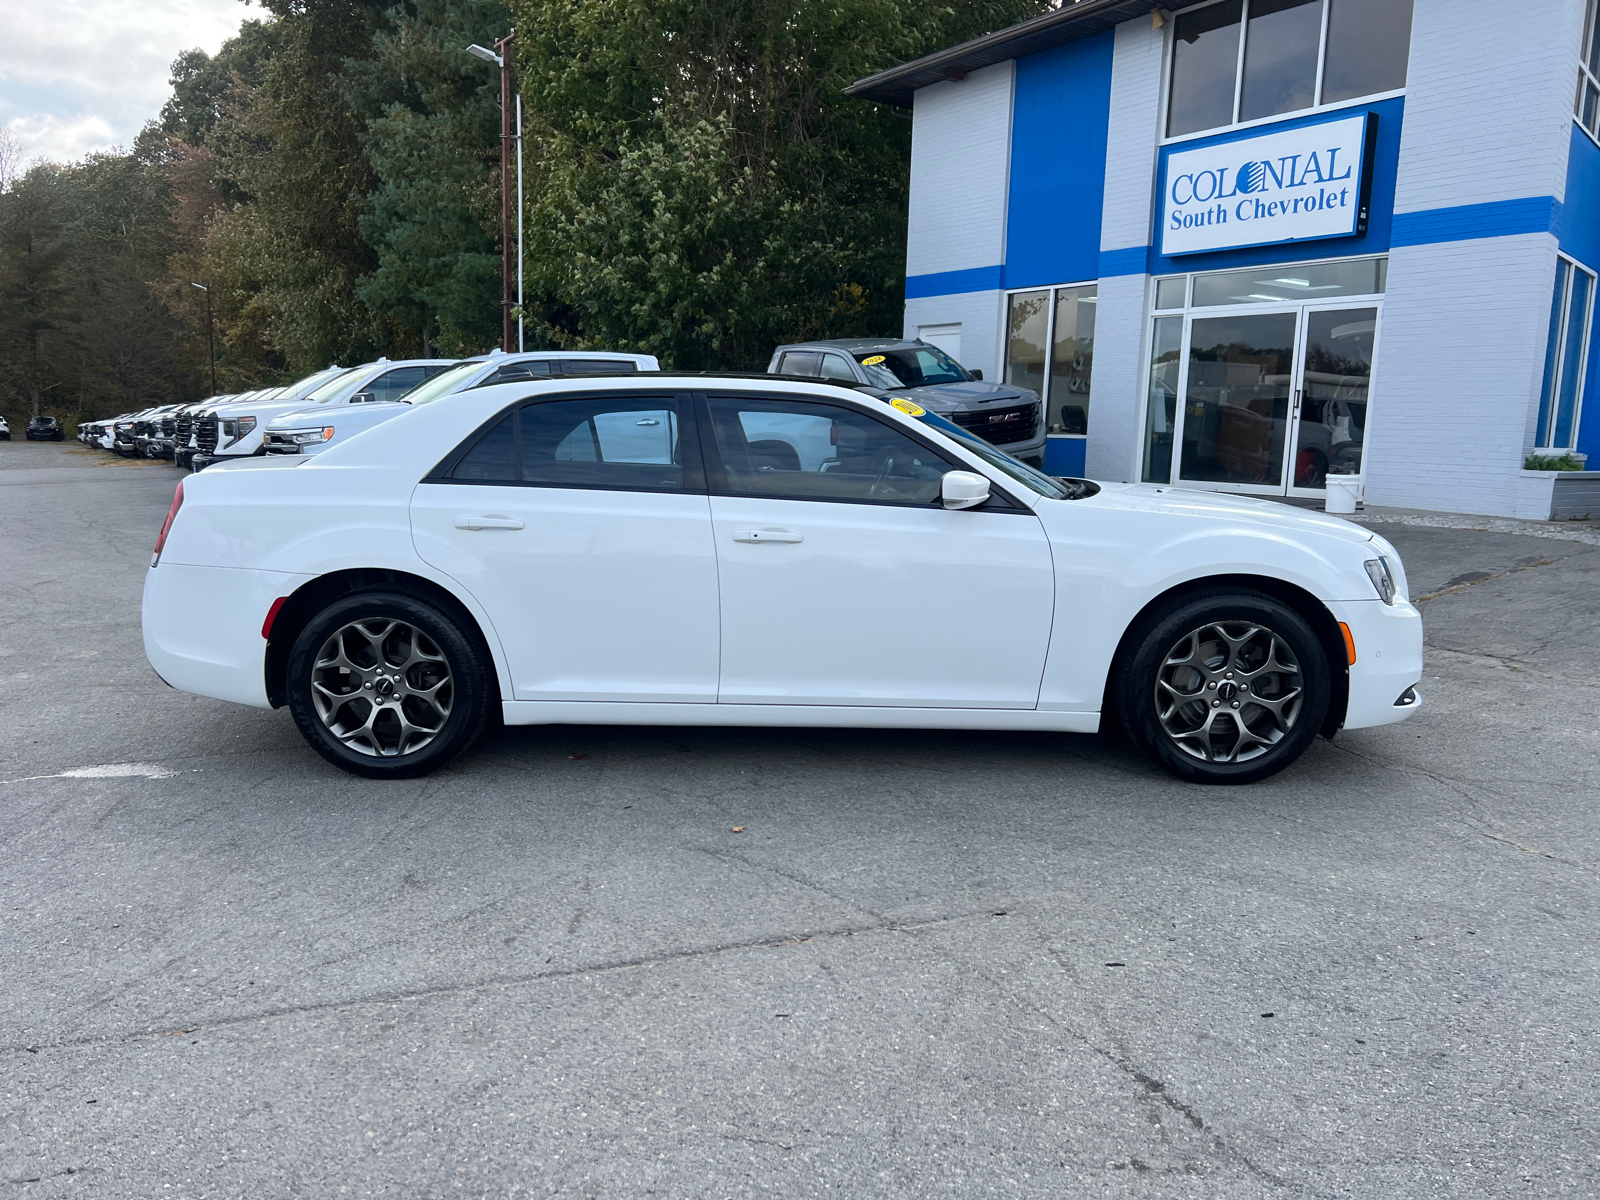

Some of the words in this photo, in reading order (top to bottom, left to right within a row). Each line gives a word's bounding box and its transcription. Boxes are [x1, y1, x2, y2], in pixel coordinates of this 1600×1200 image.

[1171, 147, 1352, 206] COLONIAL
[1170, 204, 1227, 231] South
[1235, 186, 1349, 221] Chevrolet
[988, 412, 1021, 424] GMC
